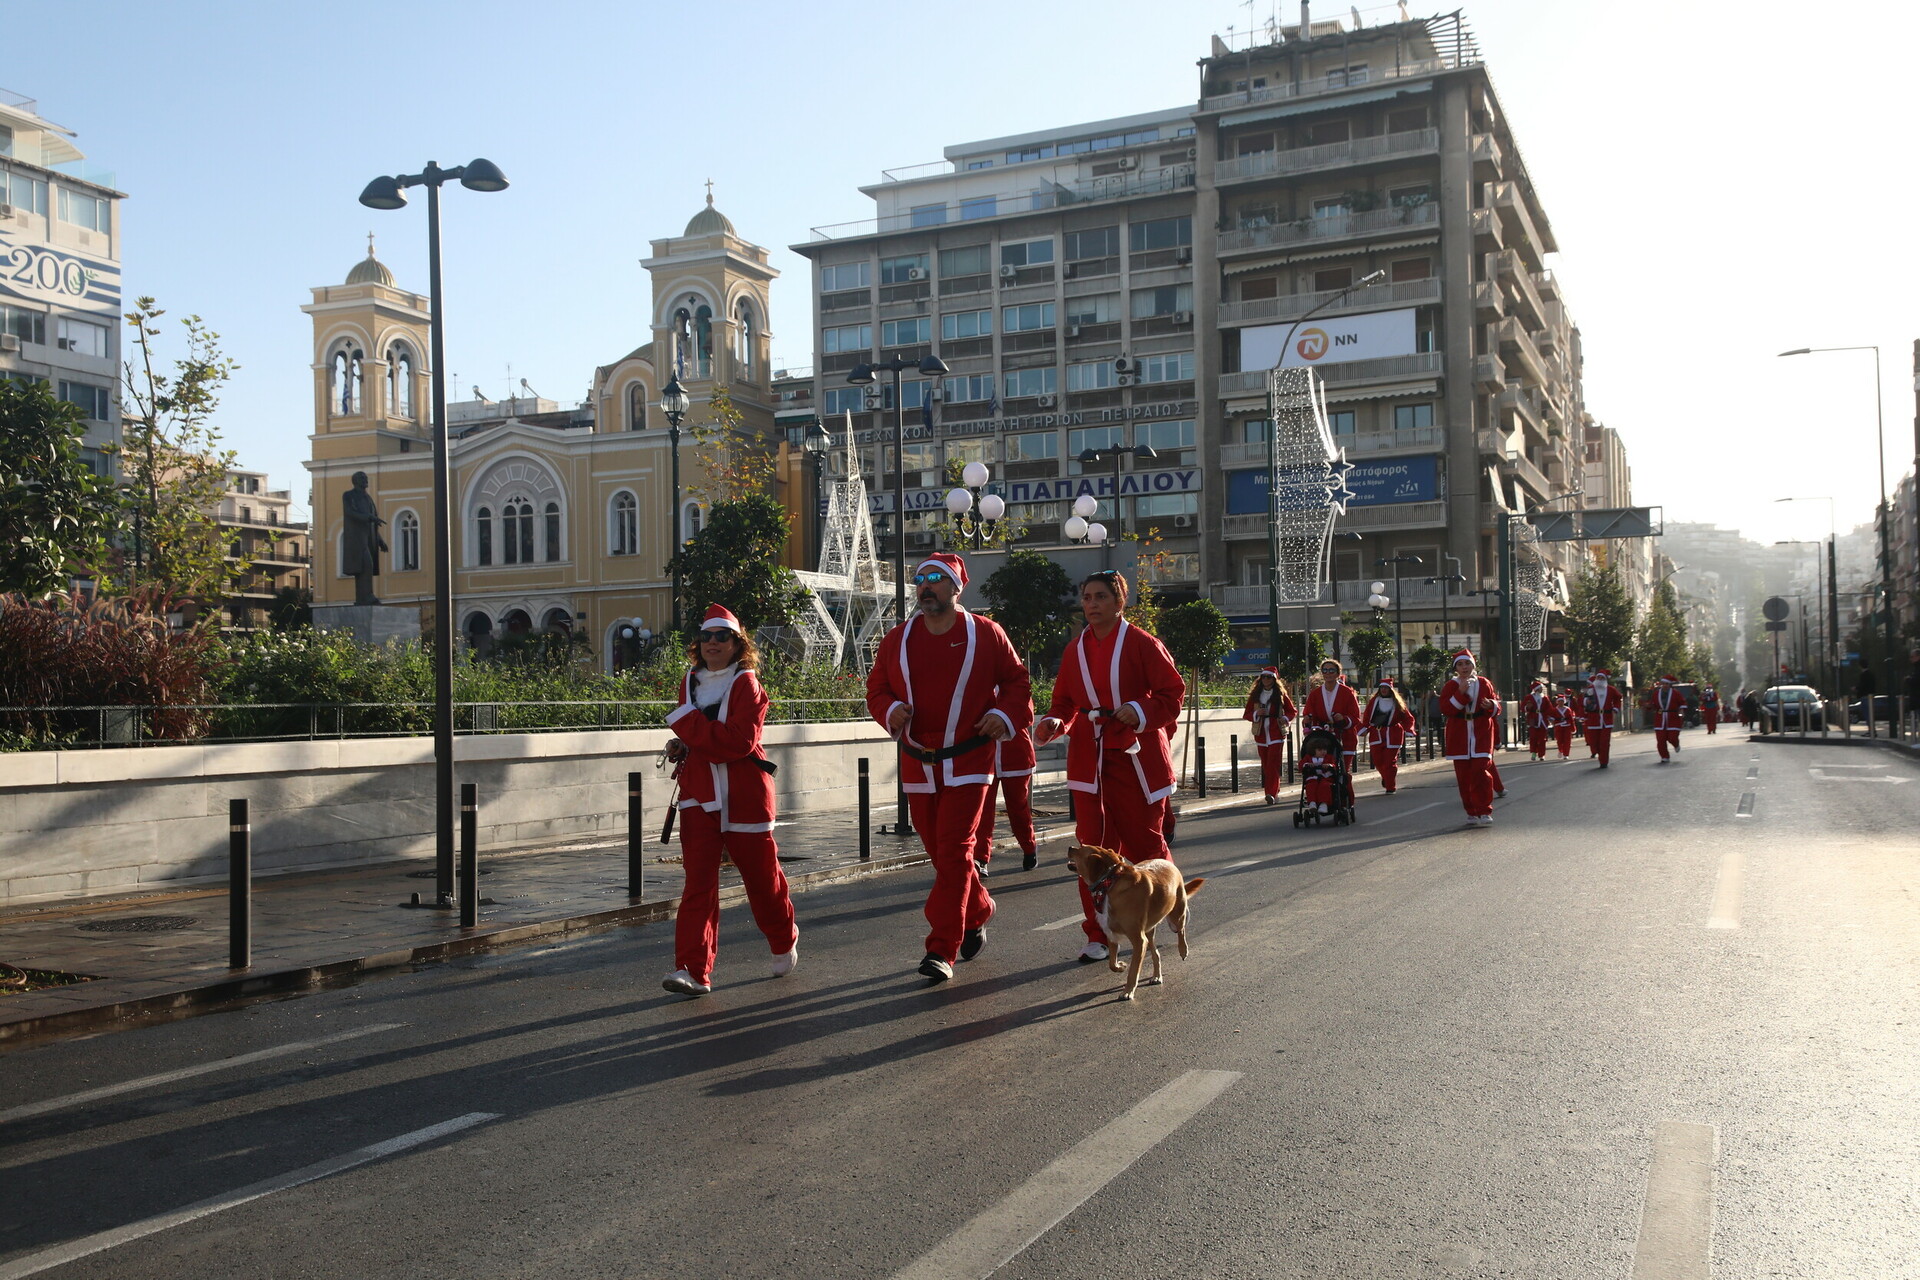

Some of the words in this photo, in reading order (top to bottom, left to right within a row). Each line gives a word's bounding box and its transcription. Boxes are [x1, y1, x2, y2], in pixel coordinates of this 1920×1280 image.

[11, 248, 86, 296] 200
[1335, 333, 1358, 346] NN
[830, 427, 932, 446] ΒΙΤΕΧΝΚΟΝ
[1102, 402, 1184, 421] ΠΕΙΡΑΙΩΣ
[1012, 471, 1195, 501] ΠΑΠΑΗΛΙΟΥ
